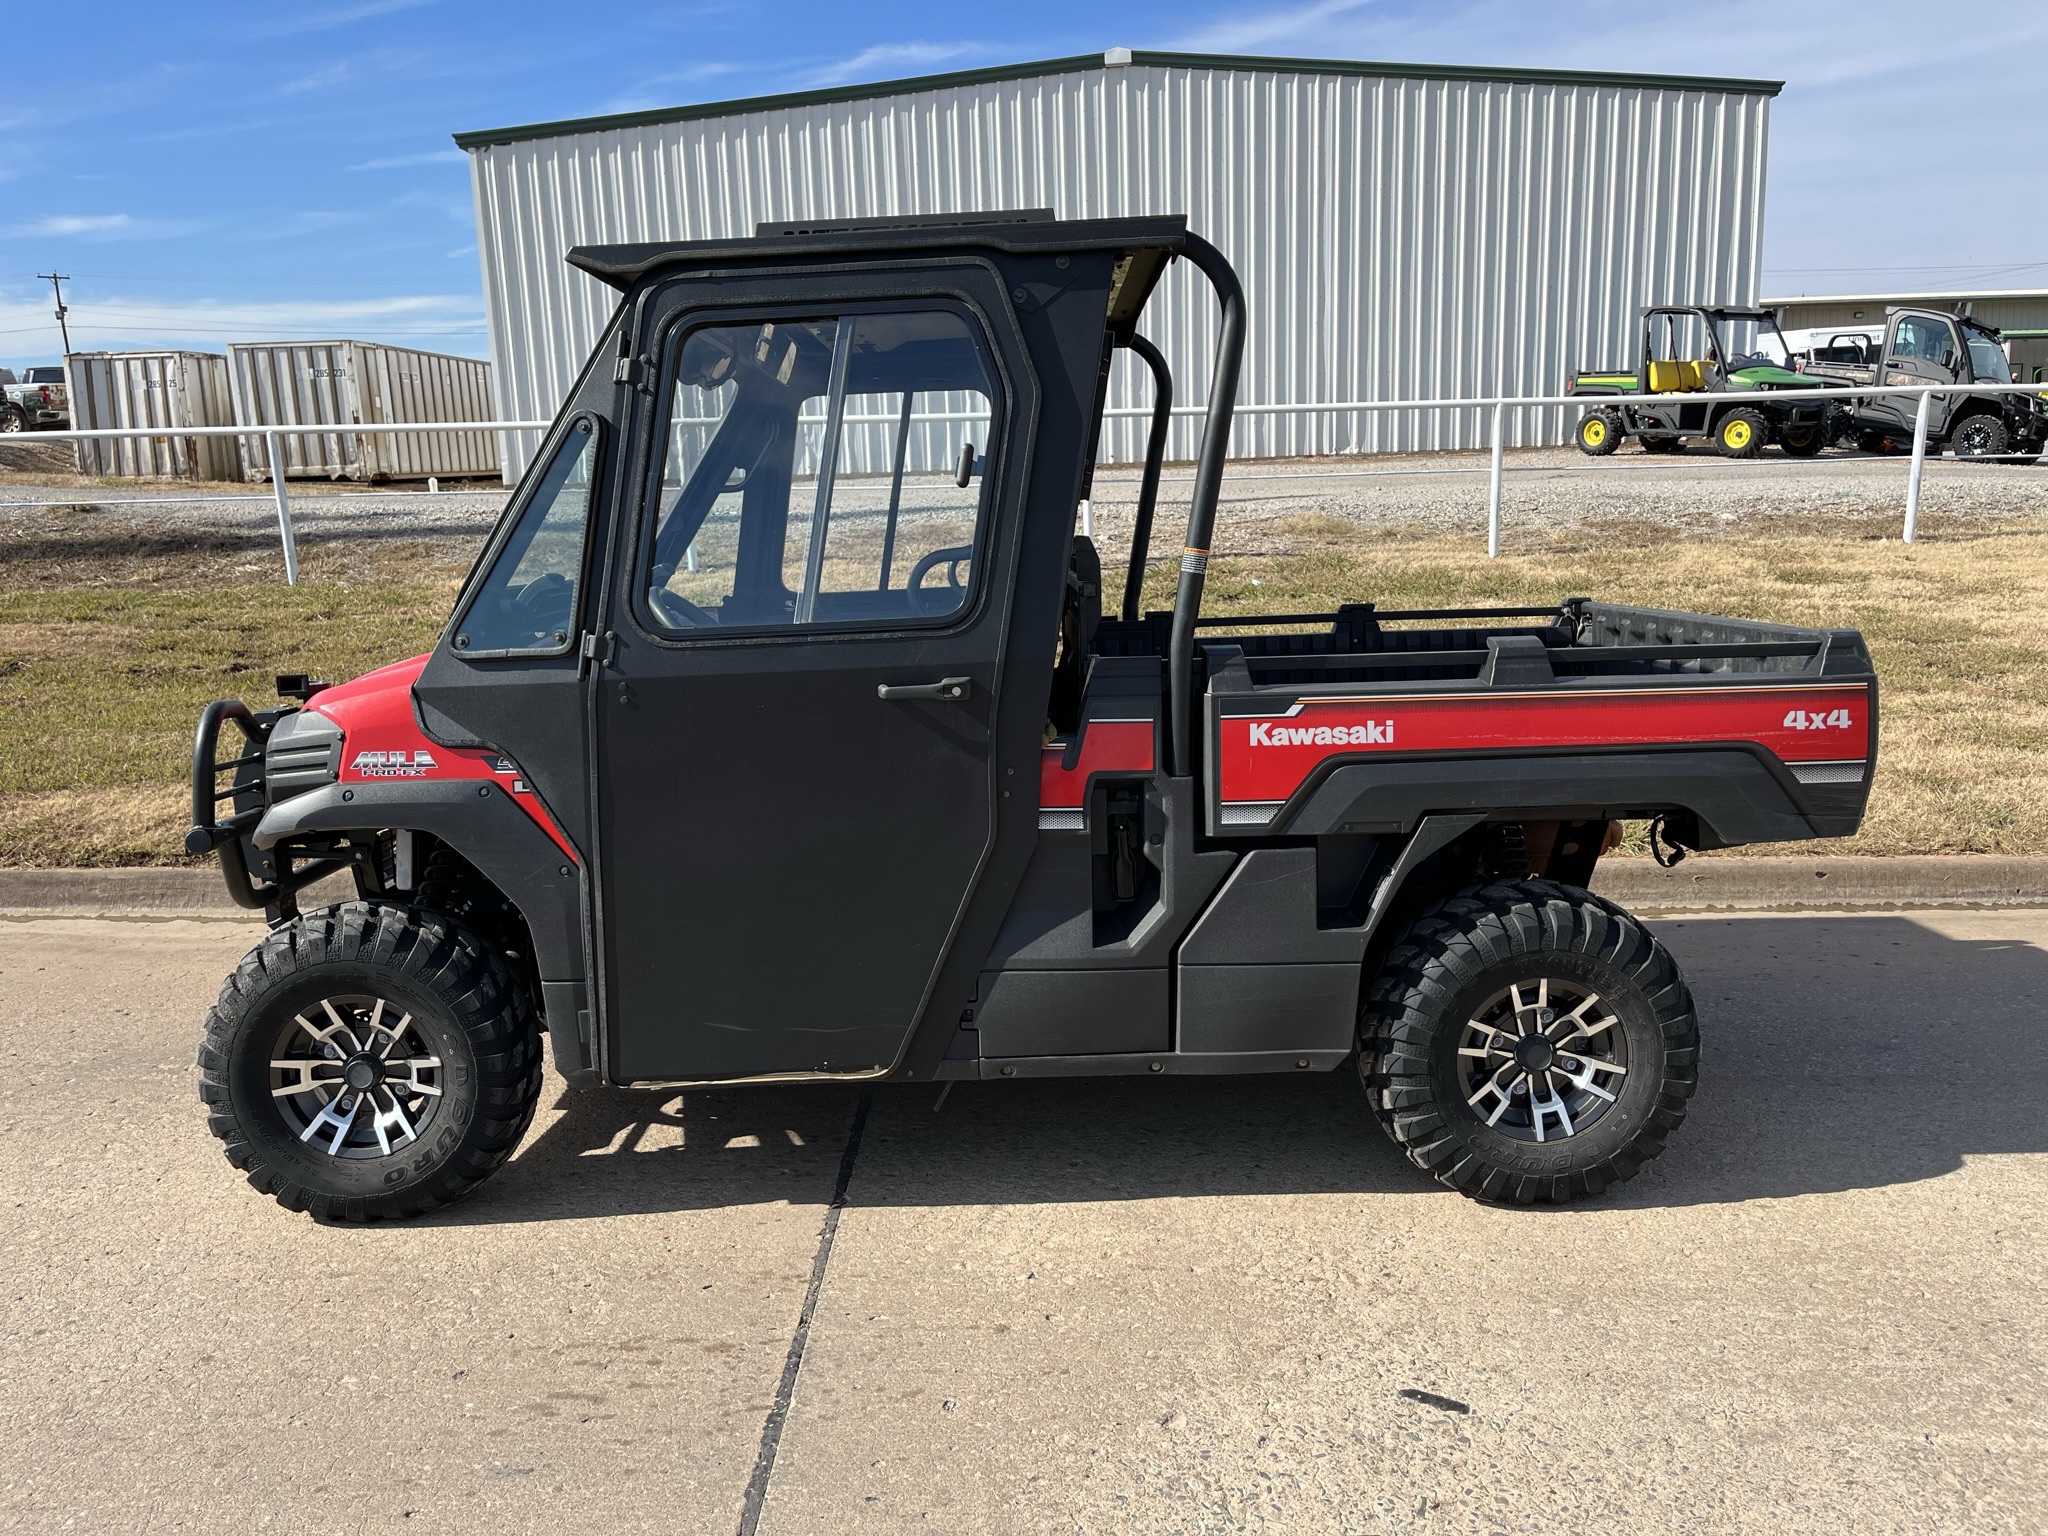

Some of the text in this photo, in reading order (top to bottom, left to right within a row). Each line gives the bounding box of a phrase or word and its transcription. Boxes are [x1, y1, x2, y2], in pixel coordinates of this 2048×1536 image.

[334, 369, 346, 377] 231
[1783, 709, 1852, 730] 4x4
[1250, 720, 1394, 746] Kawasaki
[350, 751, 438, 769] MULE
[383, 1097, 468, 1186] DURO
[1468, 1135, 1573, 1171] DURO
